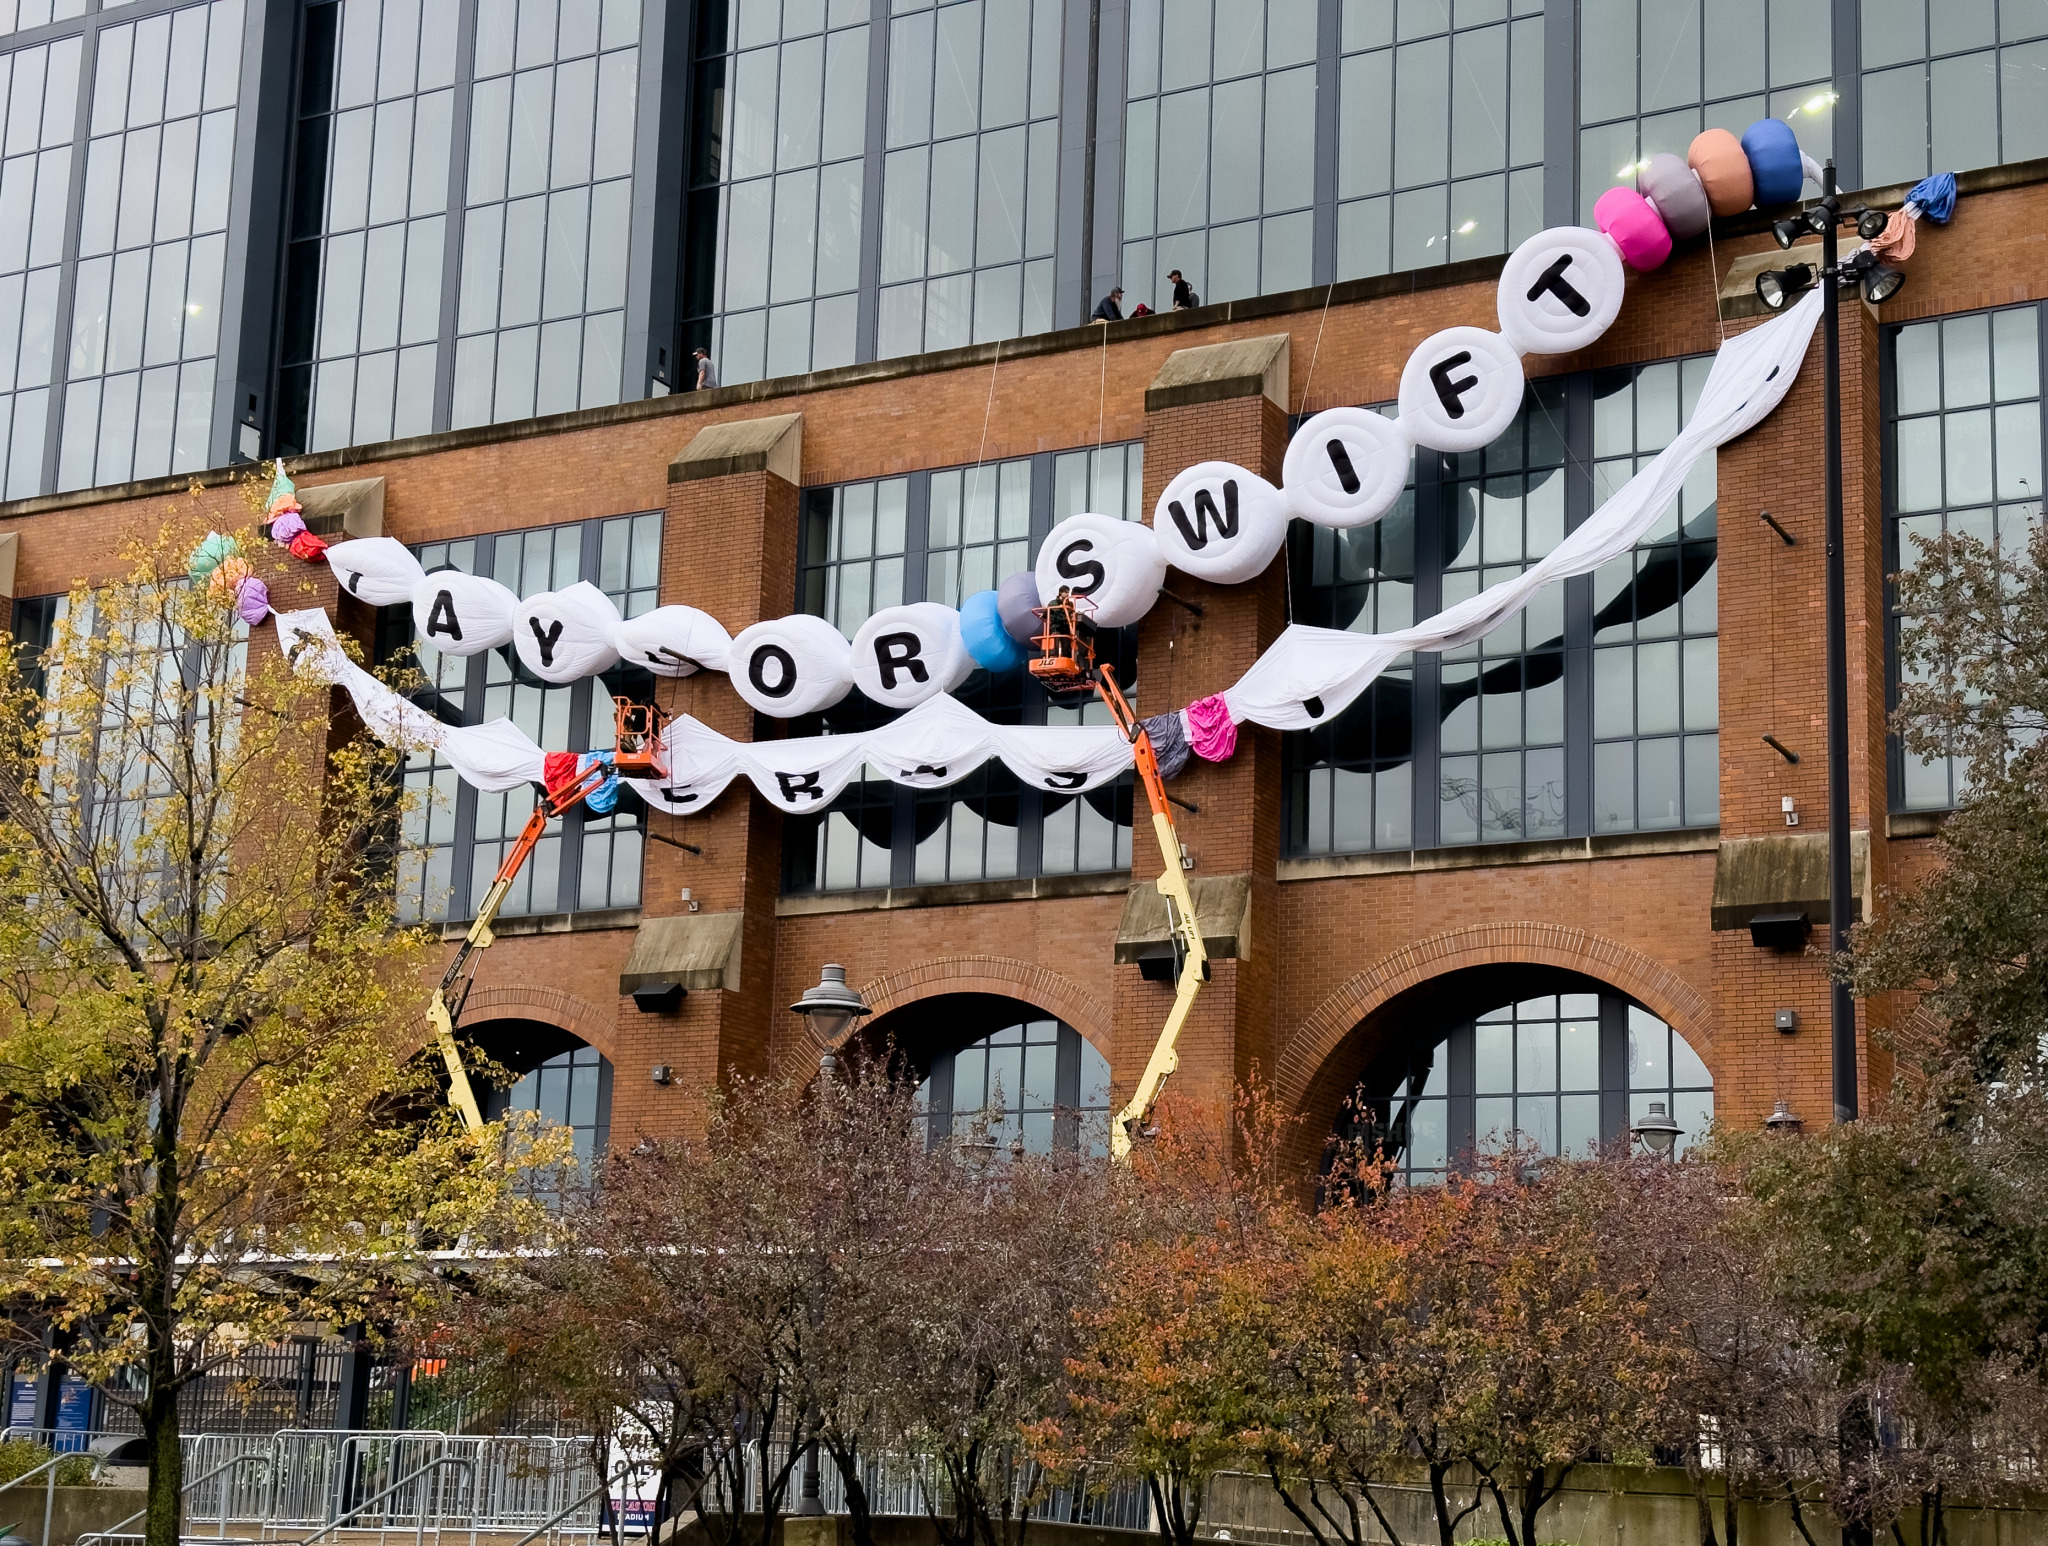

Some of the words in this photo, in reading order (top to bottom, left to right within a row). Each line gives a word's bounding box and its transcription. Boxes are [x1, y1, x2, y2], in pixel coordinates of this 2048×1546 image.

[1055, 253, 1591, 598] SWIFT
[1038, 658, 1055, 667] JLG
[617, 1513, 649, 1521] SADIUM
